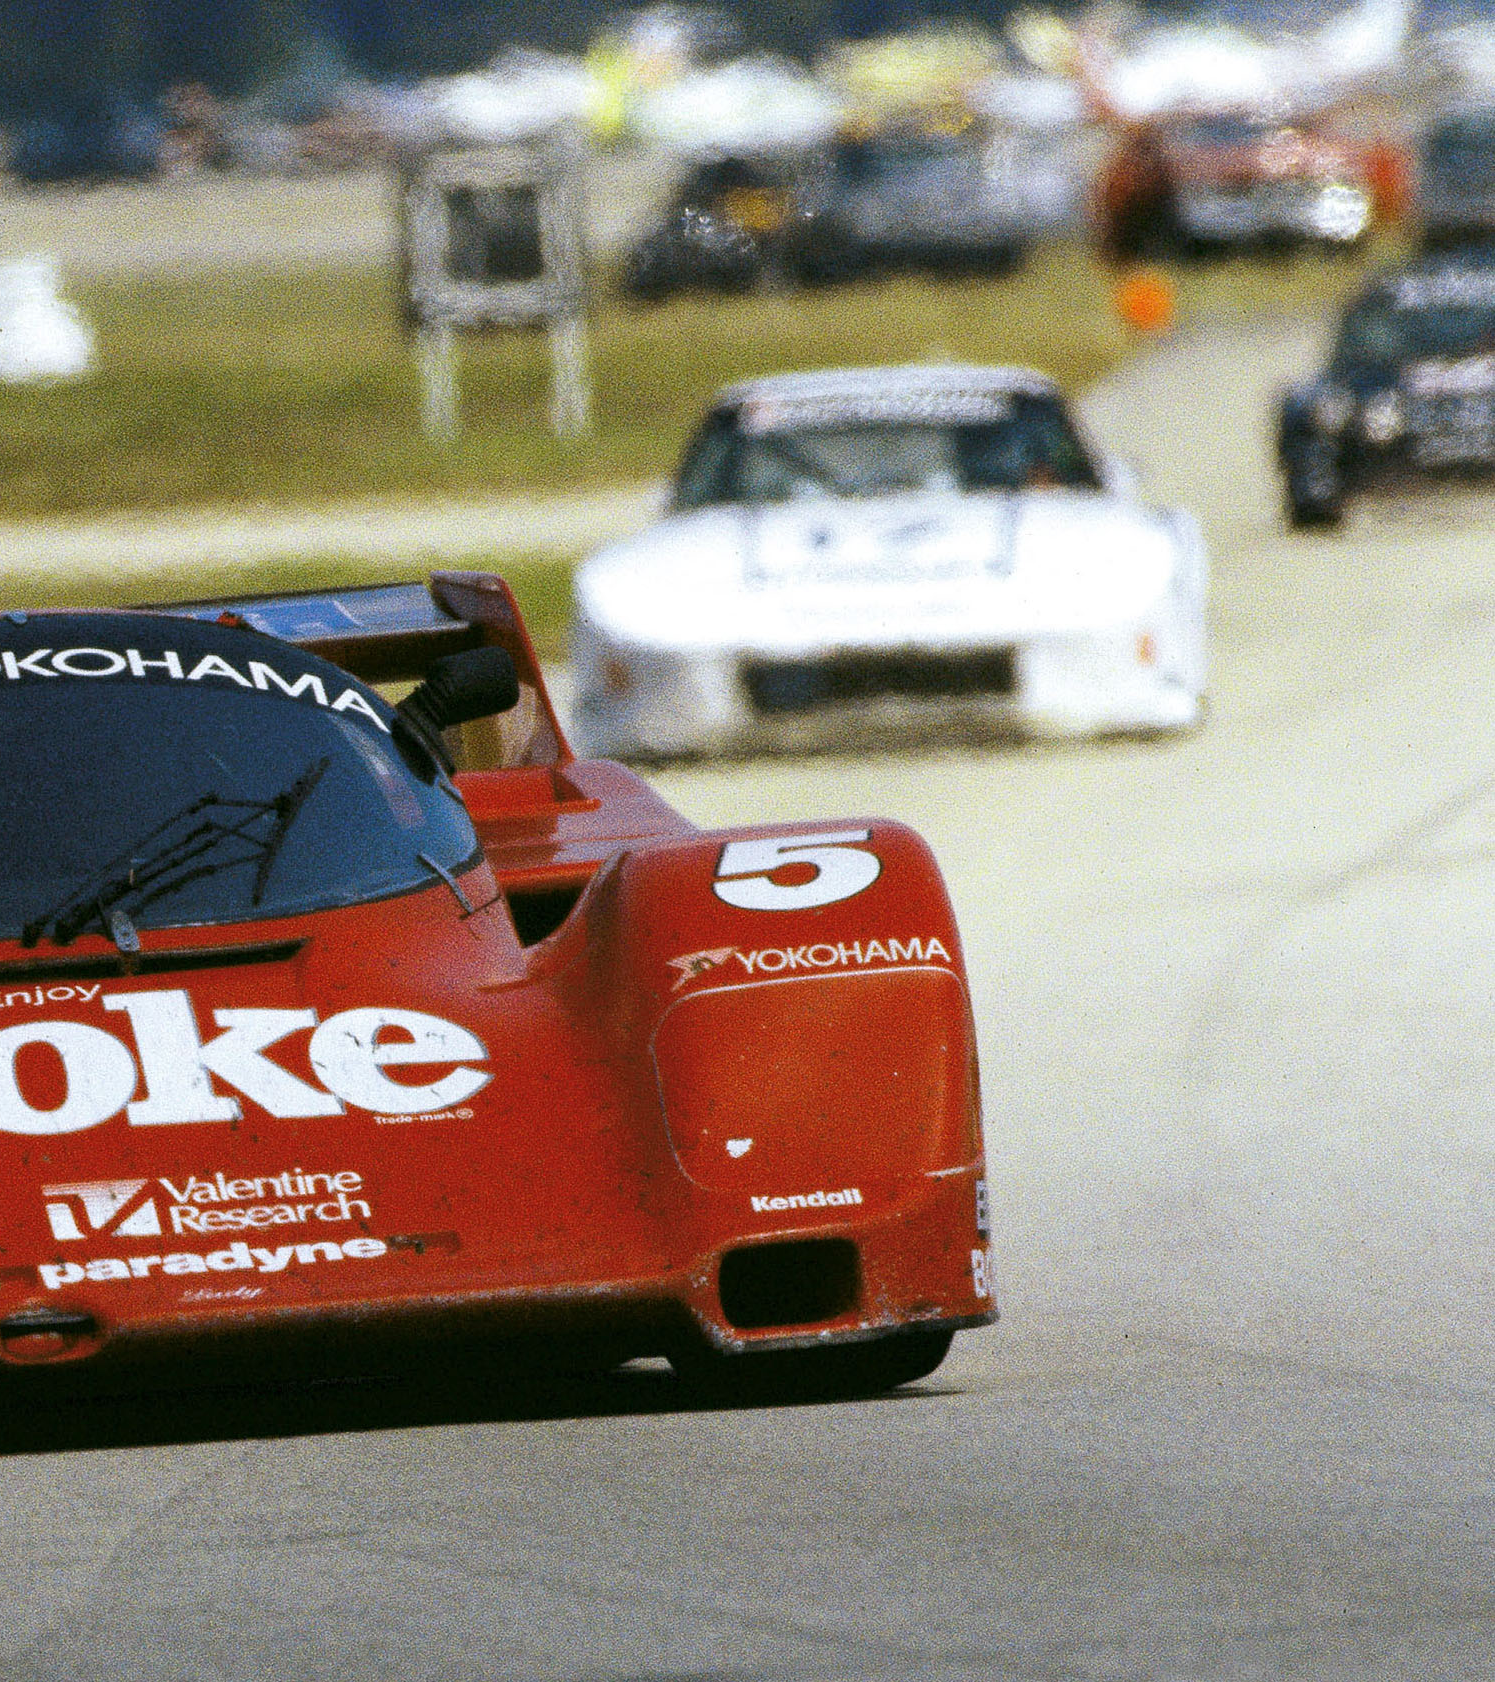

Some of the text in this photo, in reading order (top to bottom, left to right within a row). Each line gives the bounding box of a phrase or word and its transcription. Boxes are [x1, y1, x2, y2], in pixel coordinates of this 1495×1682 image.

[713, 829, 881, 911] 5
[736, 937, 951, 973] YOKOHAMA
[158, 1168, 364, 1204] Valentine
[751, 1189, 863, 1211] Kendall
[168, 1194, 372, 1234] Research
[38, 1238, 388, 1289] paradyne
